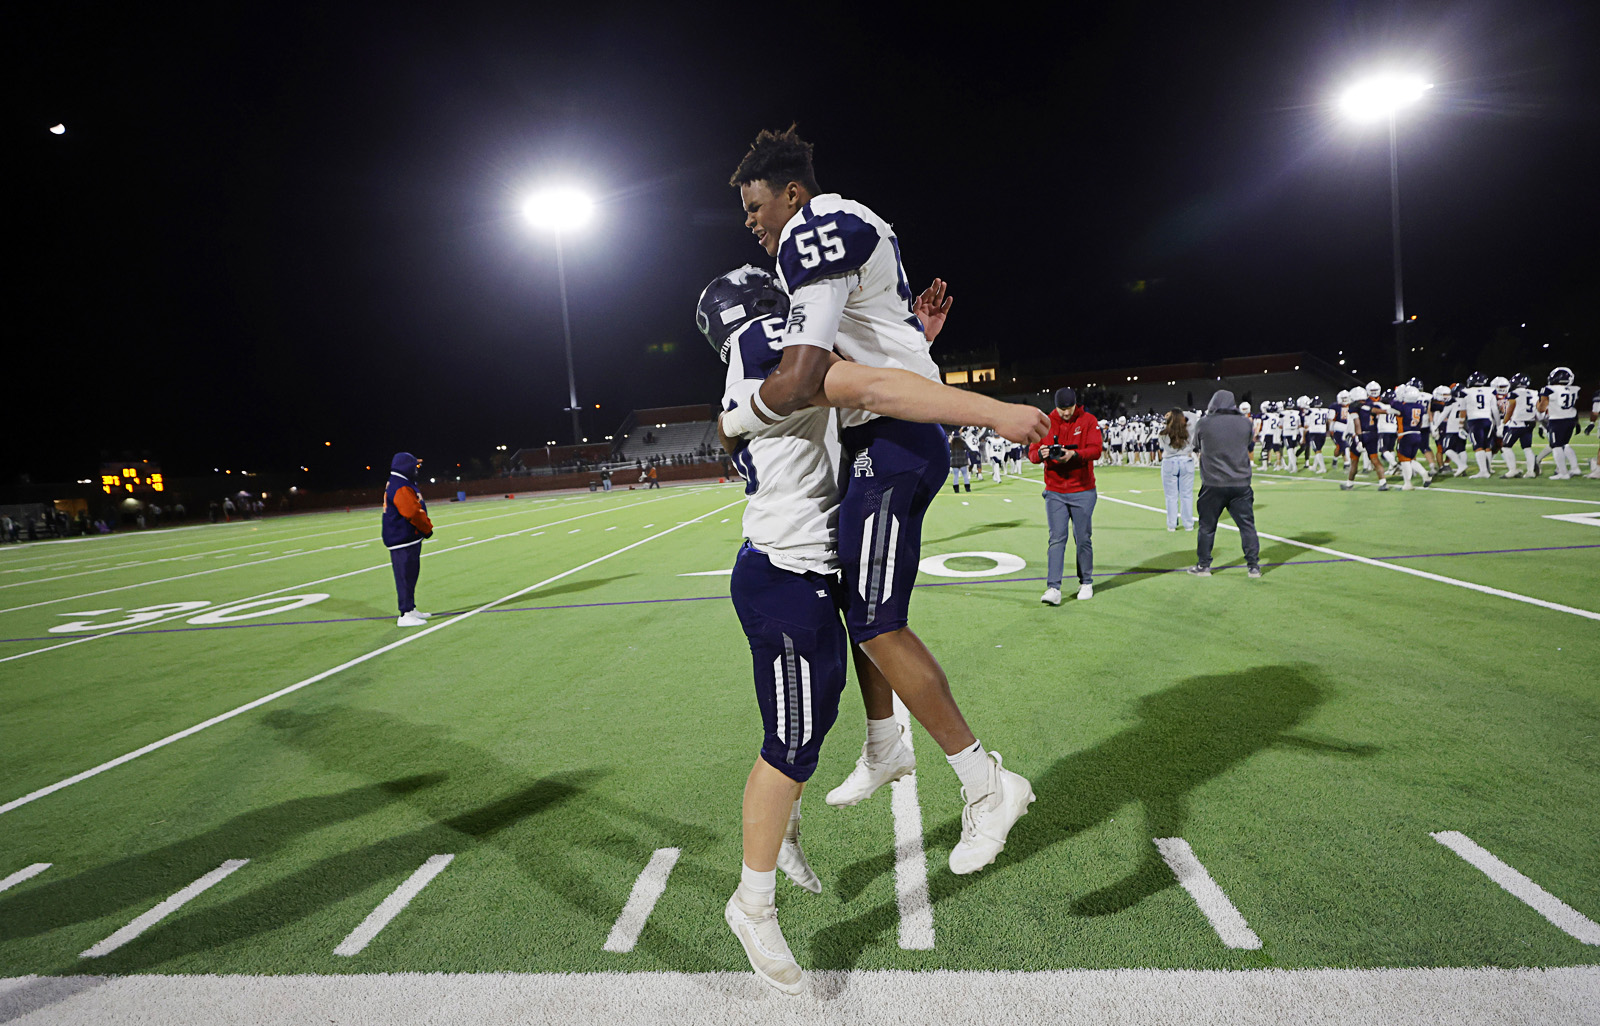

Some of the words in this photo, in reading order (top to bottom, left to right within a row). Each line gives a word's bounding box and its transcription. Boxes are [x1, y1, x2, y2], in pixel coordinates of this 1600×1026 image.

[795, 220, 846, 269] 55
[1476, 394, 1485, 410] 9
[1526, 396, 1534, 413] 5
[1289, 415, 1296, 427] 2
